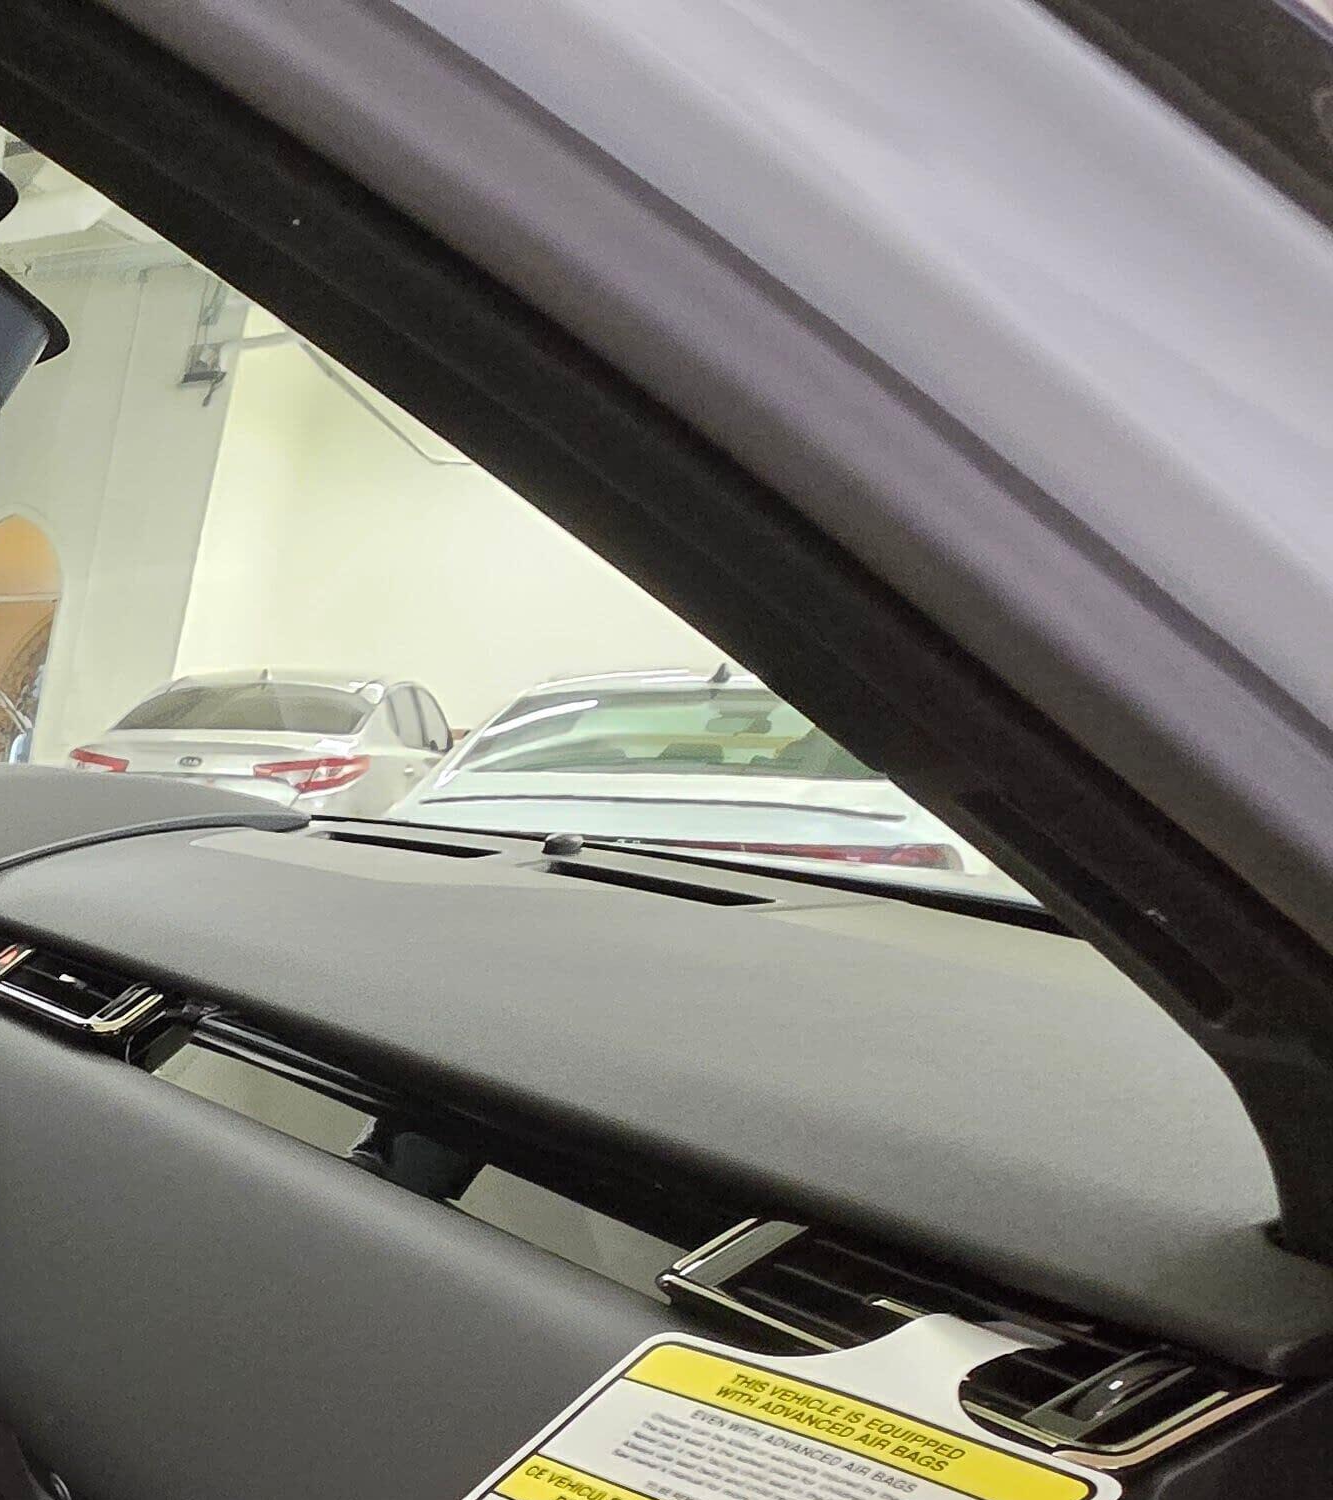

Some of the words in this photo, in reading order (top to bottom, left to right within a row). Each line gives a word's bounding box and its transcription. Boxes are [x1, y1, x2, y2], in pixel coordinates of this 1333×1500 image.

[714, 1386, 760, 1405] WITH
[757, 1400, 856, 1438] ADVANCED
[853, 1432, 891, 1450] AIR
[888, 1445, 950, 1472] BAGS
[729, 1374, 769, 1392] THIS
[767, 1386, 844, 1416] VEHICLE
[842, 1410, 866, 1423] IS
[863, 1418, 968, 1460] EQUIPPED
[523, 1464, 549, 1479] CE
[762, 1434, 843, 1466] ADVANCED
[870, 1471, 918, 1493] BAGS
